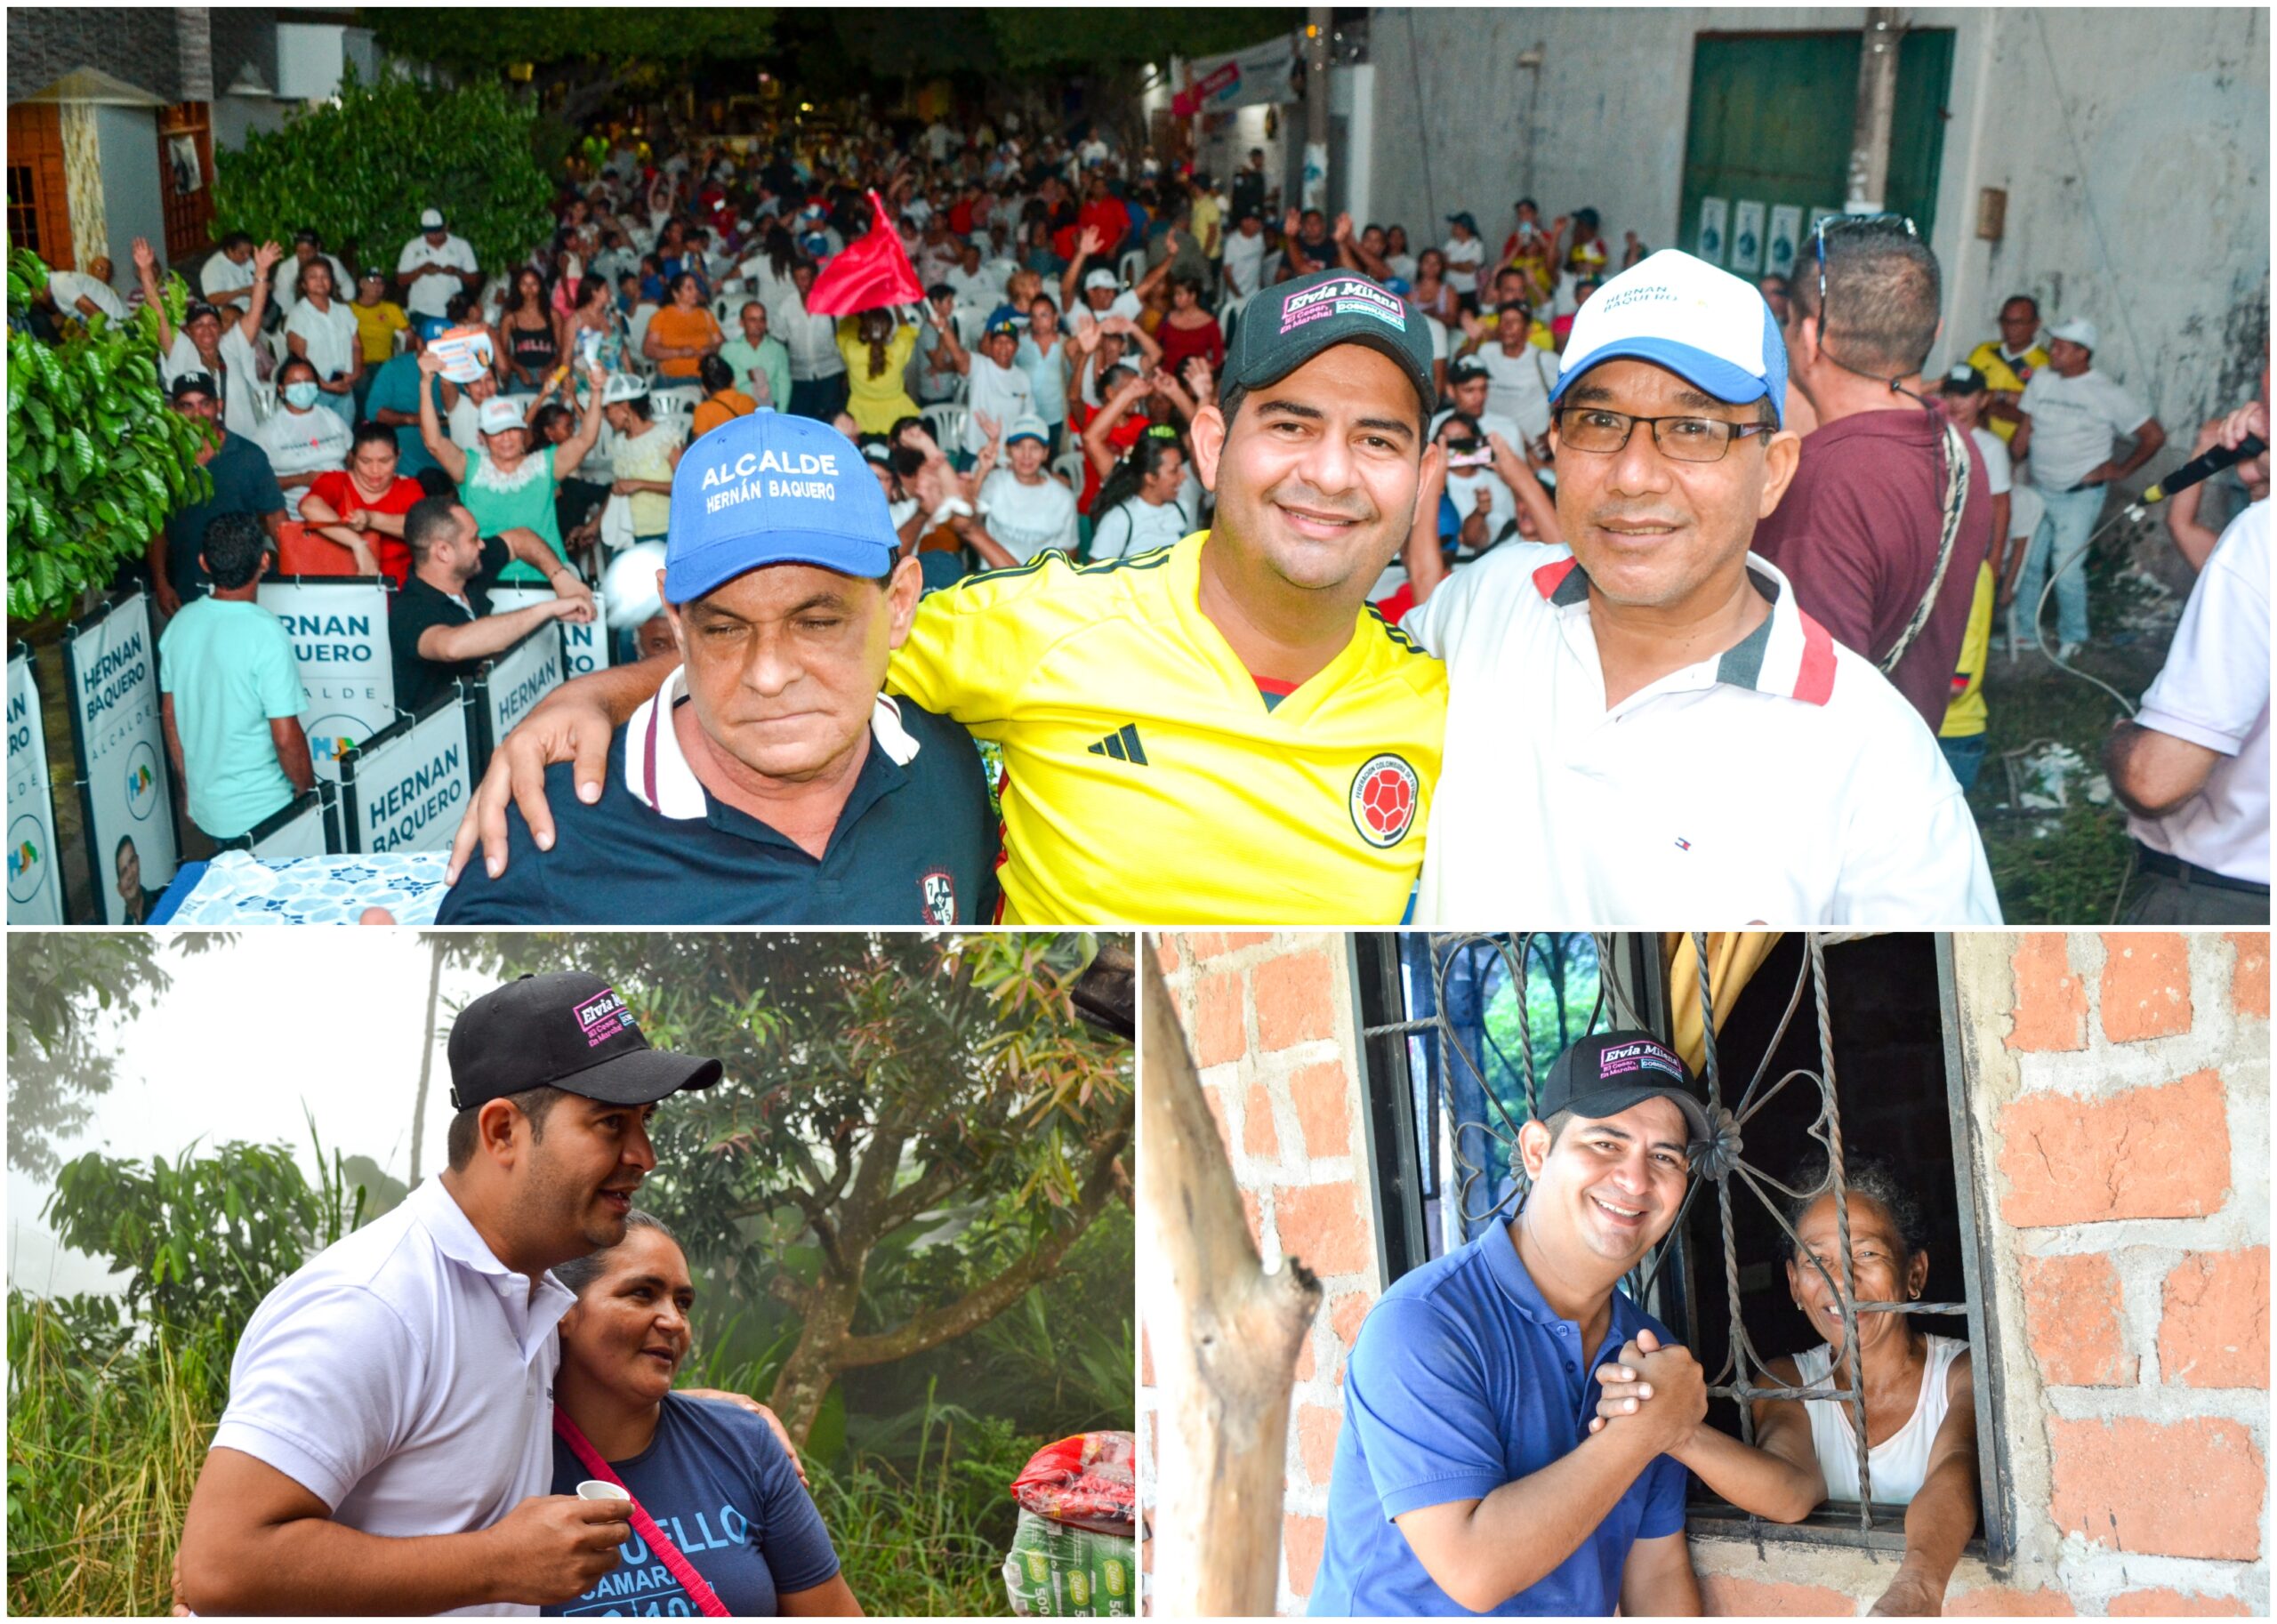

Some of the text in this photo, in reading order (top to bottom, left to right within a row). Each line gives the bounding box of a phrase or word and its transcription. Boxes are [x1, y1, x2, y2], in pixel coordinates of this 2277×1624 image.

[1287, 283, 1399, 313] Elvia Milena
[702, 449, 839, 491] ALCALDE
[706, 478, 835, 515] HERNÁN BAQUERO
[278, 615, 370, 637] RNAN
[84, 631, 142, 695] HERNAN
[294, 644, 373, 662] UERO
[86, 662, 145, 722] BAQUERO
[303, 687, 376, 699] ALDE
[498, 655, 557, 725] HERNAN
[93, 704, 151, 760] ALCALDE
[370, 743, 459, 830] HERNAN
[581, 999, 615, 1025] Elvia
[1605, 1044, 1678, 1067] Elvia Milena
[580, 1564, 678, 1601] AMAR
[1034, 1588, 1050, 1614] 500
